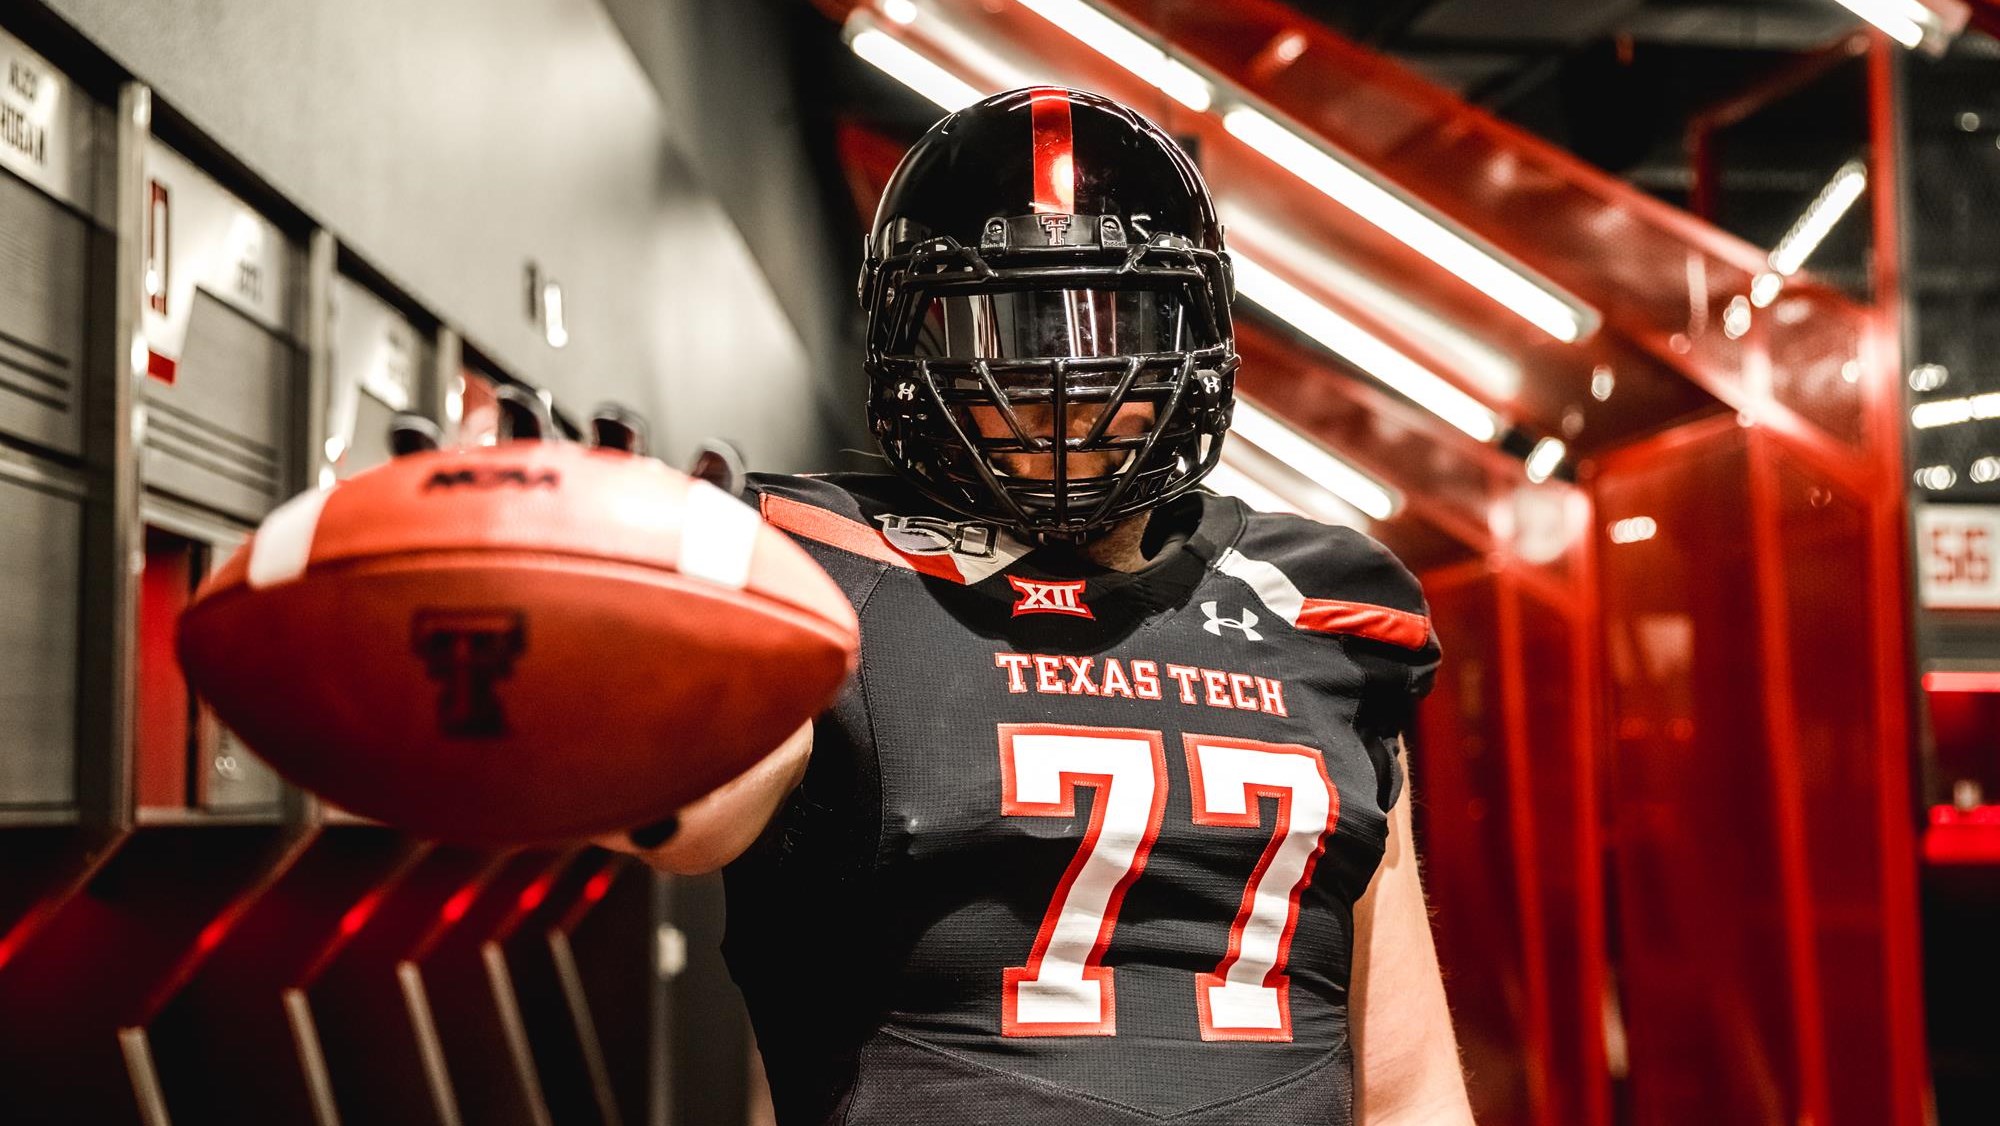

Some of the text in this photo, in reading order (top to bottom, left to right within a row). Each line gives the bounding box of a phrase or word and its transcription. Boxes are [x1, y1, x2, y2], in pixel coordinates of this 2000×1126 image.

[1012, 579, 1088, 615] XII
[995, 653, 1289, 718] TEXAS TECH
[997, 723, 1340, 1042] 77
